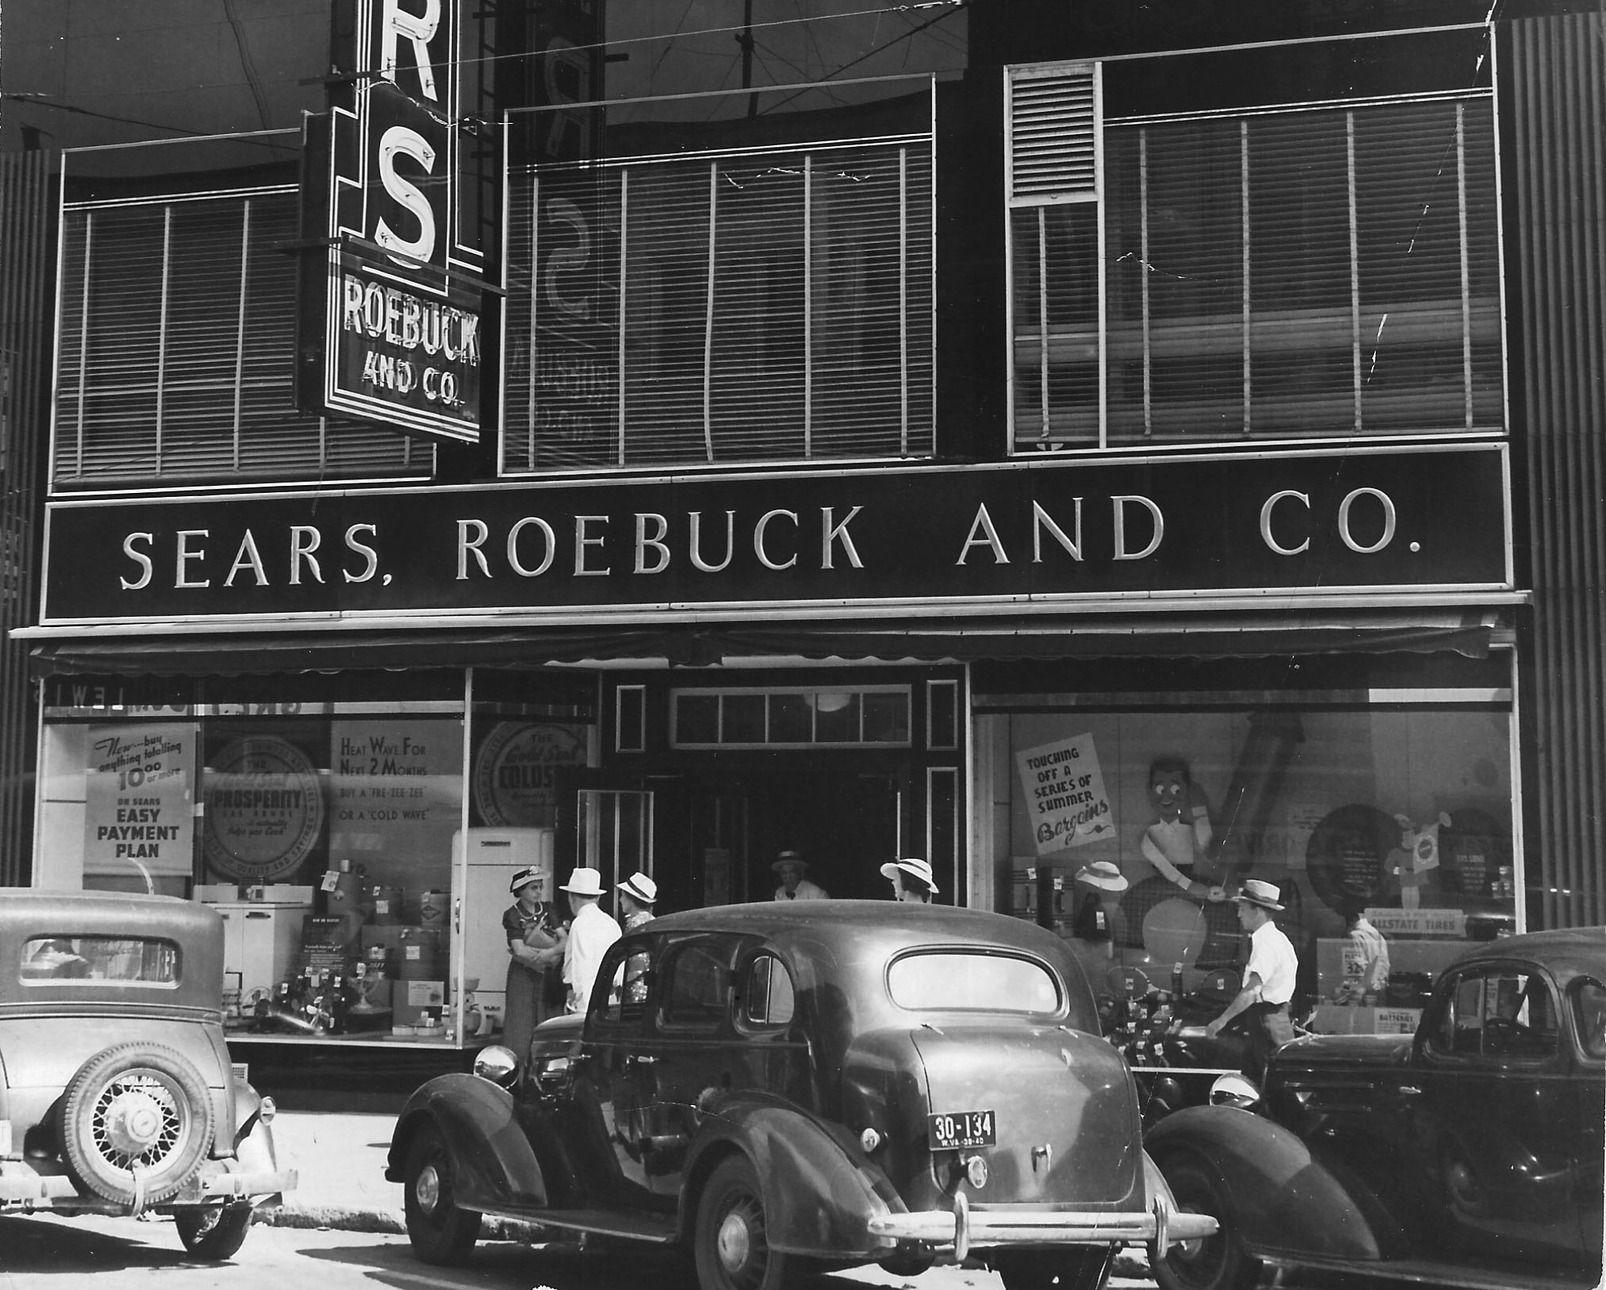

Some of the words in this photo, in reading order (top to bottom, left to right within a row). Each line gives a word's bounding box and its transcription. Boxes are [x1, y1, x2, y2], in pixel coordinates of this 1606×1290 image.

[344, 274, 480, 366] ROEBUCK
[361, 351, 418, 393] AND
[120, 524, 392, 590] SEARS,
[456, 506, 865, 580] ROEBUCK
[955, 495, 1164, 565] AND
[1259, 487, 1421, 556] CO.
[99, 754, 141, 773] anything
[370, 758, 378, 775] 2
[1027, 747, 1080, 770] TOUCHING
[1037, 768, 1058, 783] OFF
[1064, 765, 1071, 776] A
[1034, 779, 1076, 798] SERIES
[1078, 774, 1091, 787] OF
[133, 798, 161, 806] SEARS
[213, 790, 302, 808] PROSPERITY
[1038, 791, 1094, 813] SUMMER
[117, 809, 160, 823] EASY
[340, 810, 354, 820] OR
[98, 826, 180, 840] PAYMENT
[116, 844, 159, 858] PLAN
[1425, 919, 1455, 930] TIRES
[935, 1113, 991, 1140] 30-134
